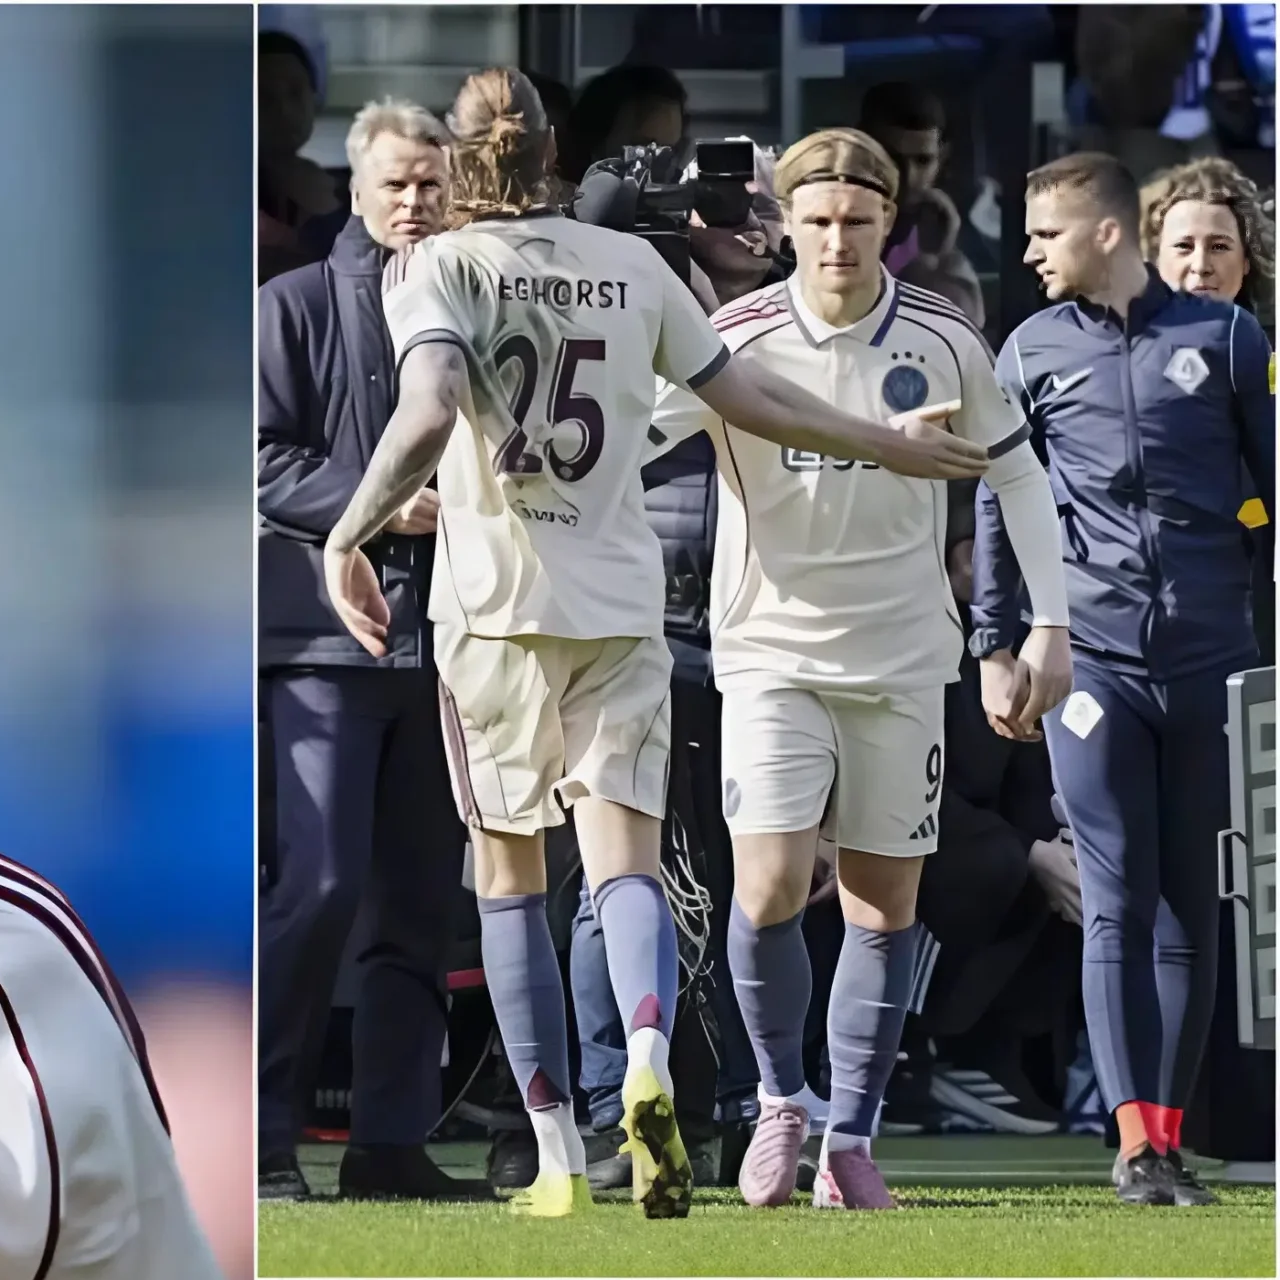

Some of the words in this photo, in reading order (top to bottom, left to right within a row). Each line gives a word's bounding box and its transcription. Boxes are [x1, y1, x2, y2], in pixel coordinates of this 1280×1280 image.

[499, 274, 628, 309] EGHORST
[491, 334, 606, 483] 25
[925, 743, 941, 804] 9
